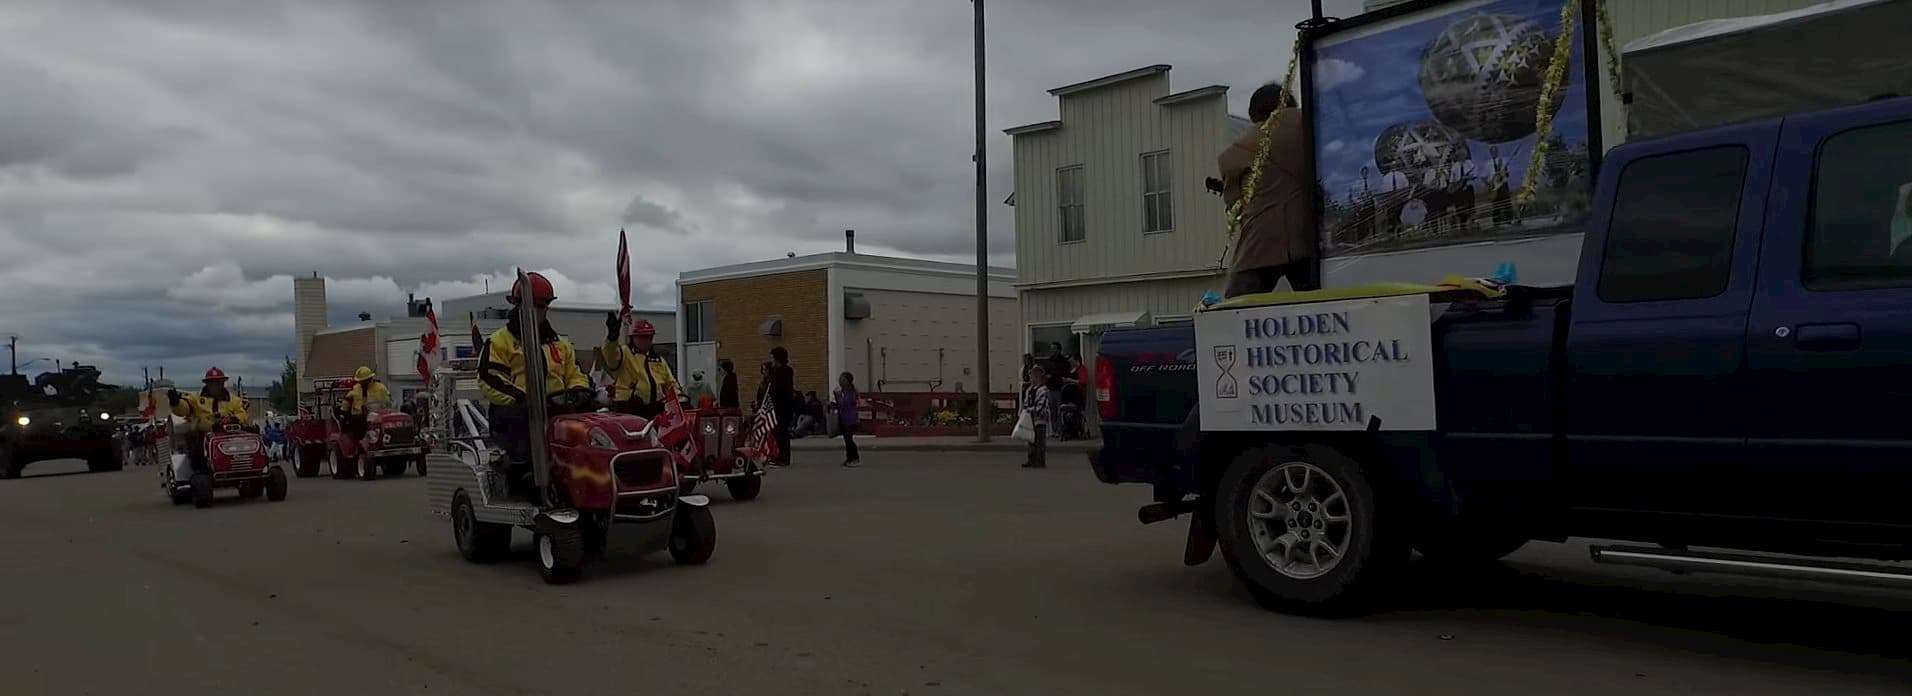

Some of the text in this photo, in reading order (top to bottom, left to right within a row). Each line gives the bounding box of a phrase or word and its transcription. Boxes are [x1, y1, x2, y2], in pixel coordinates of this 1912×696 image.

[1244, 312, 1350, 338] HOLDEN
[1247, 340, 1408, 367] HISTORICAL
[1130, 364, 1156, 372] OFF
[1249, 371, 1358, 396] SOCIETY
[1251, 402, 1363, 425] MUSEUM
